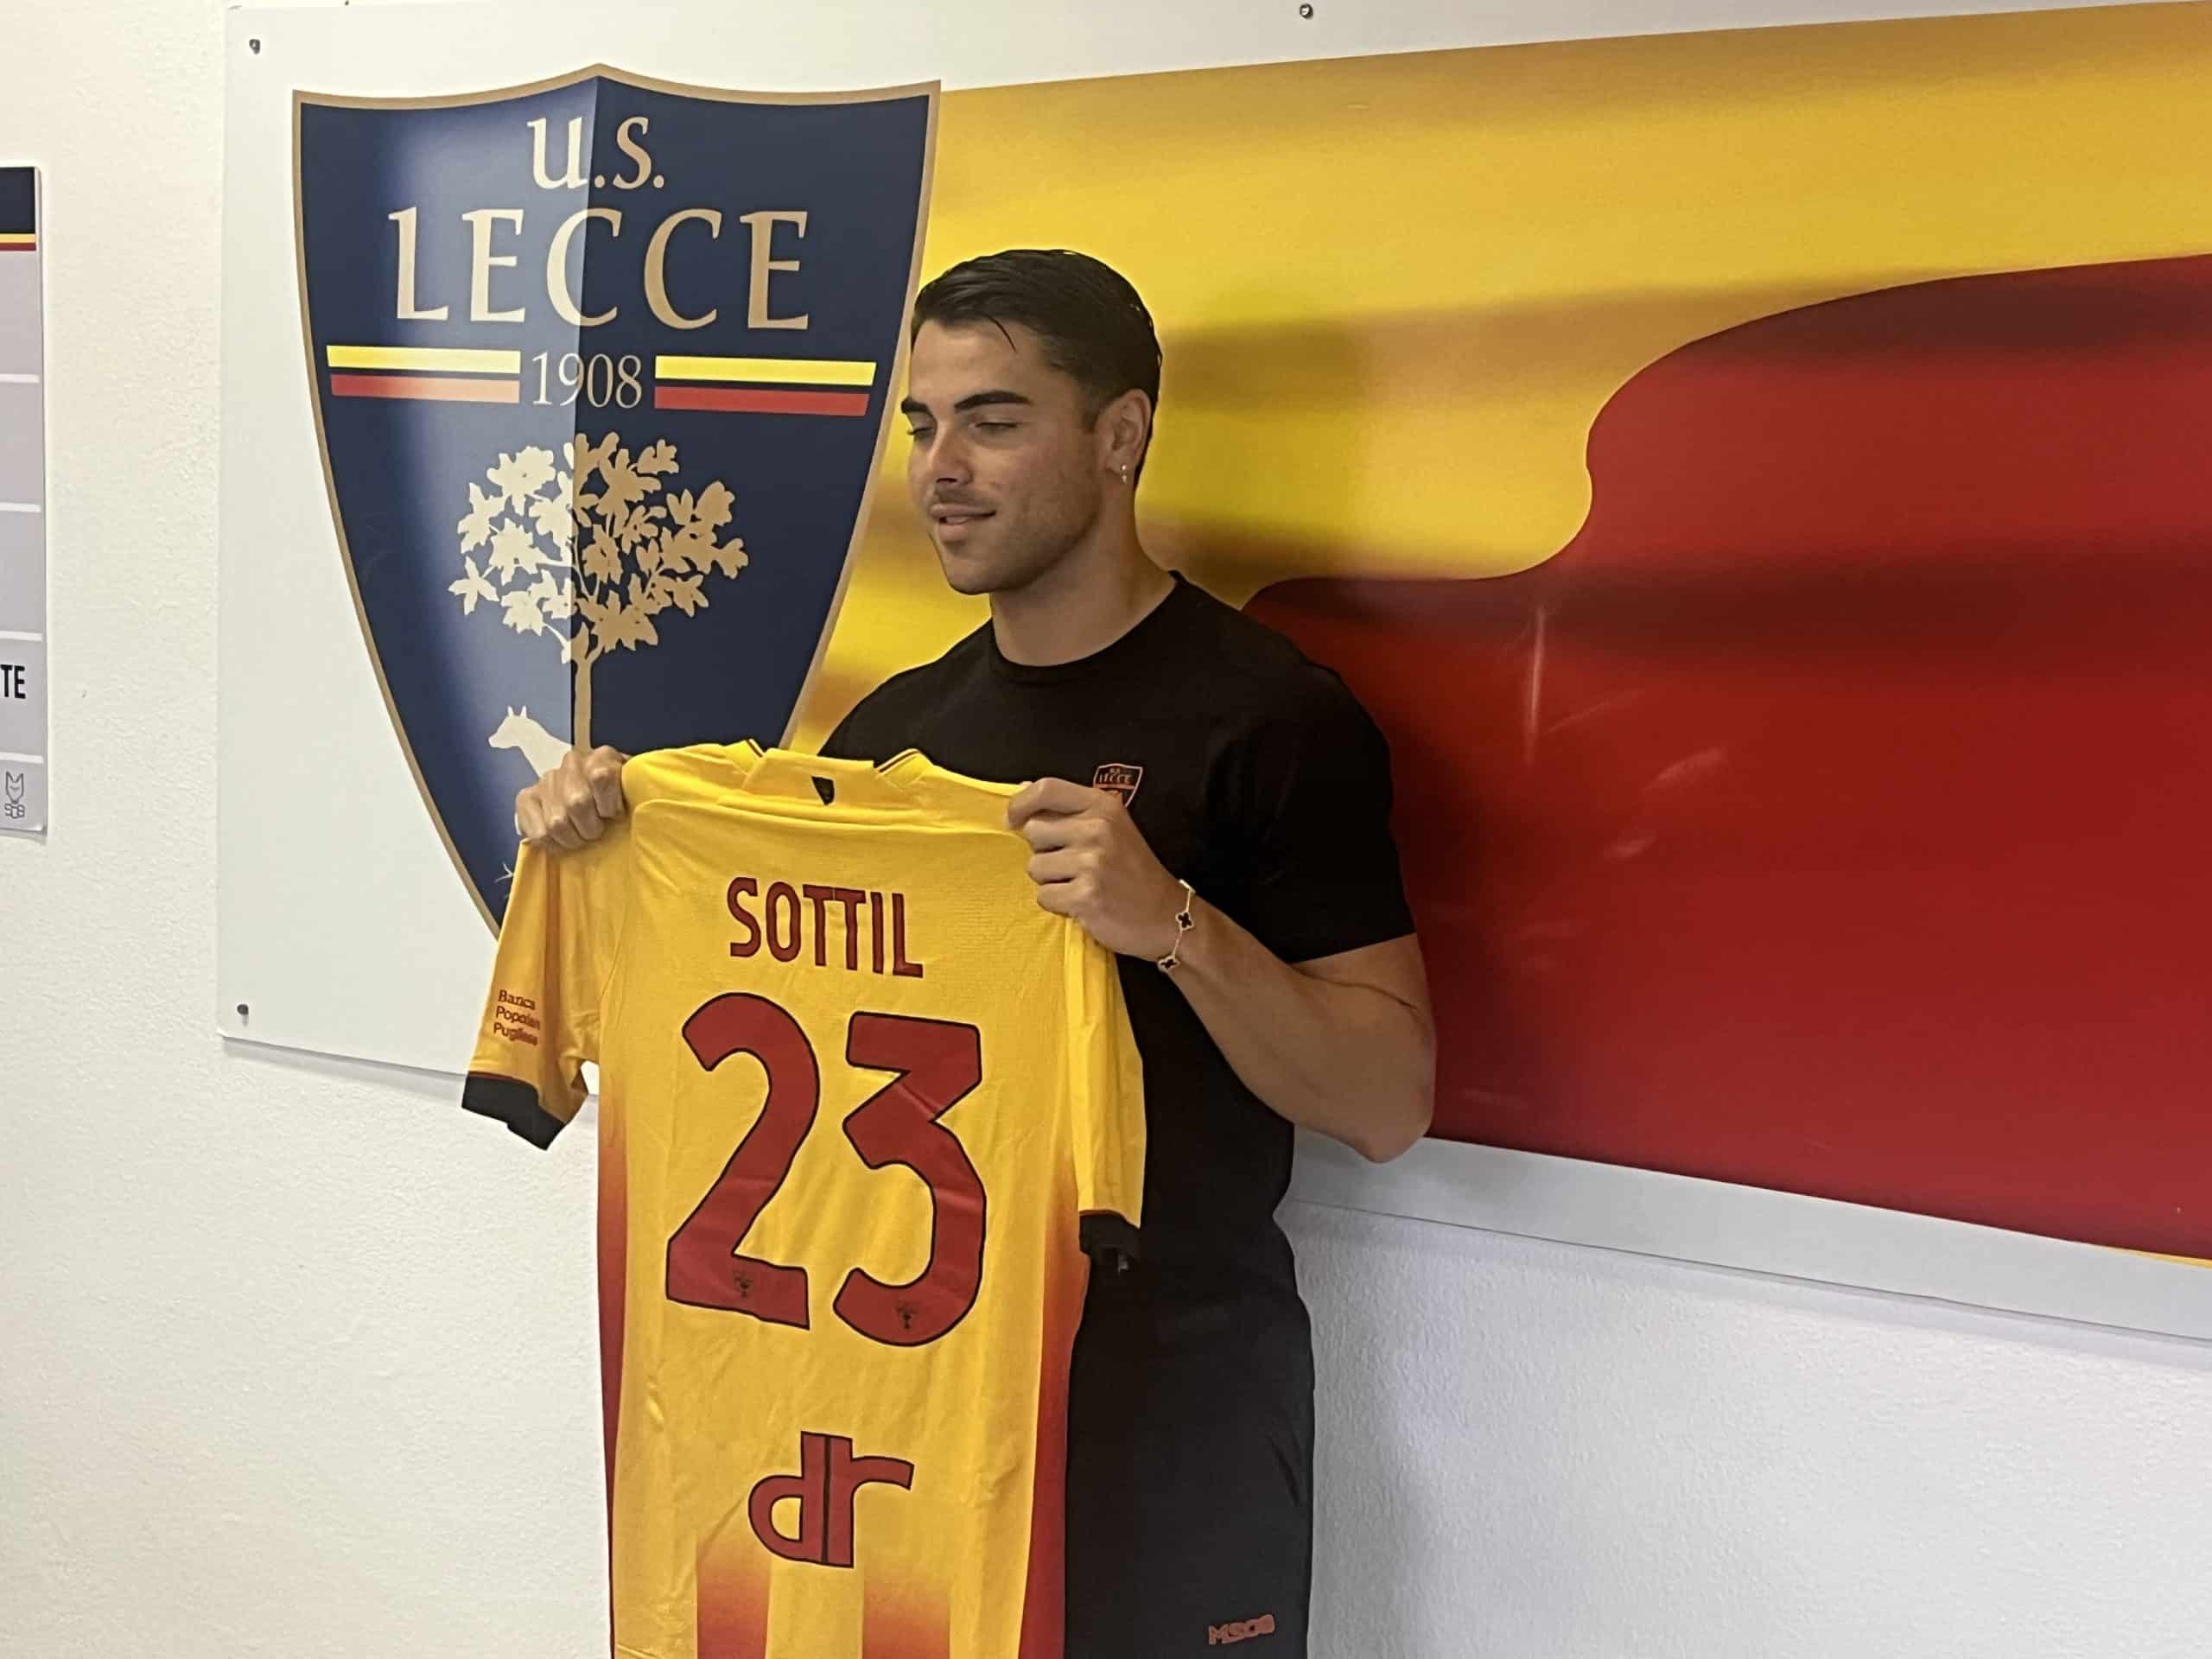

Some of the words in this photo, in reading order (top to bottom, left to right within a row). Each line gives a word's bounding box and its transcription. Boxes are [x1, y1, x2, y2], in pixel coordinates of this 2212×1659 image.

[526, 116, 664, 189] U.S.
[387, 207, 809, 330] LECCE
[531, 351, 643, 409] 1908
[727, 876, 924, 978] SOTTIL
[498, 989, 536, 1010] Banca
[665, 992, 987, 1347] 23
[747, 1430, 914, 1568] dr
